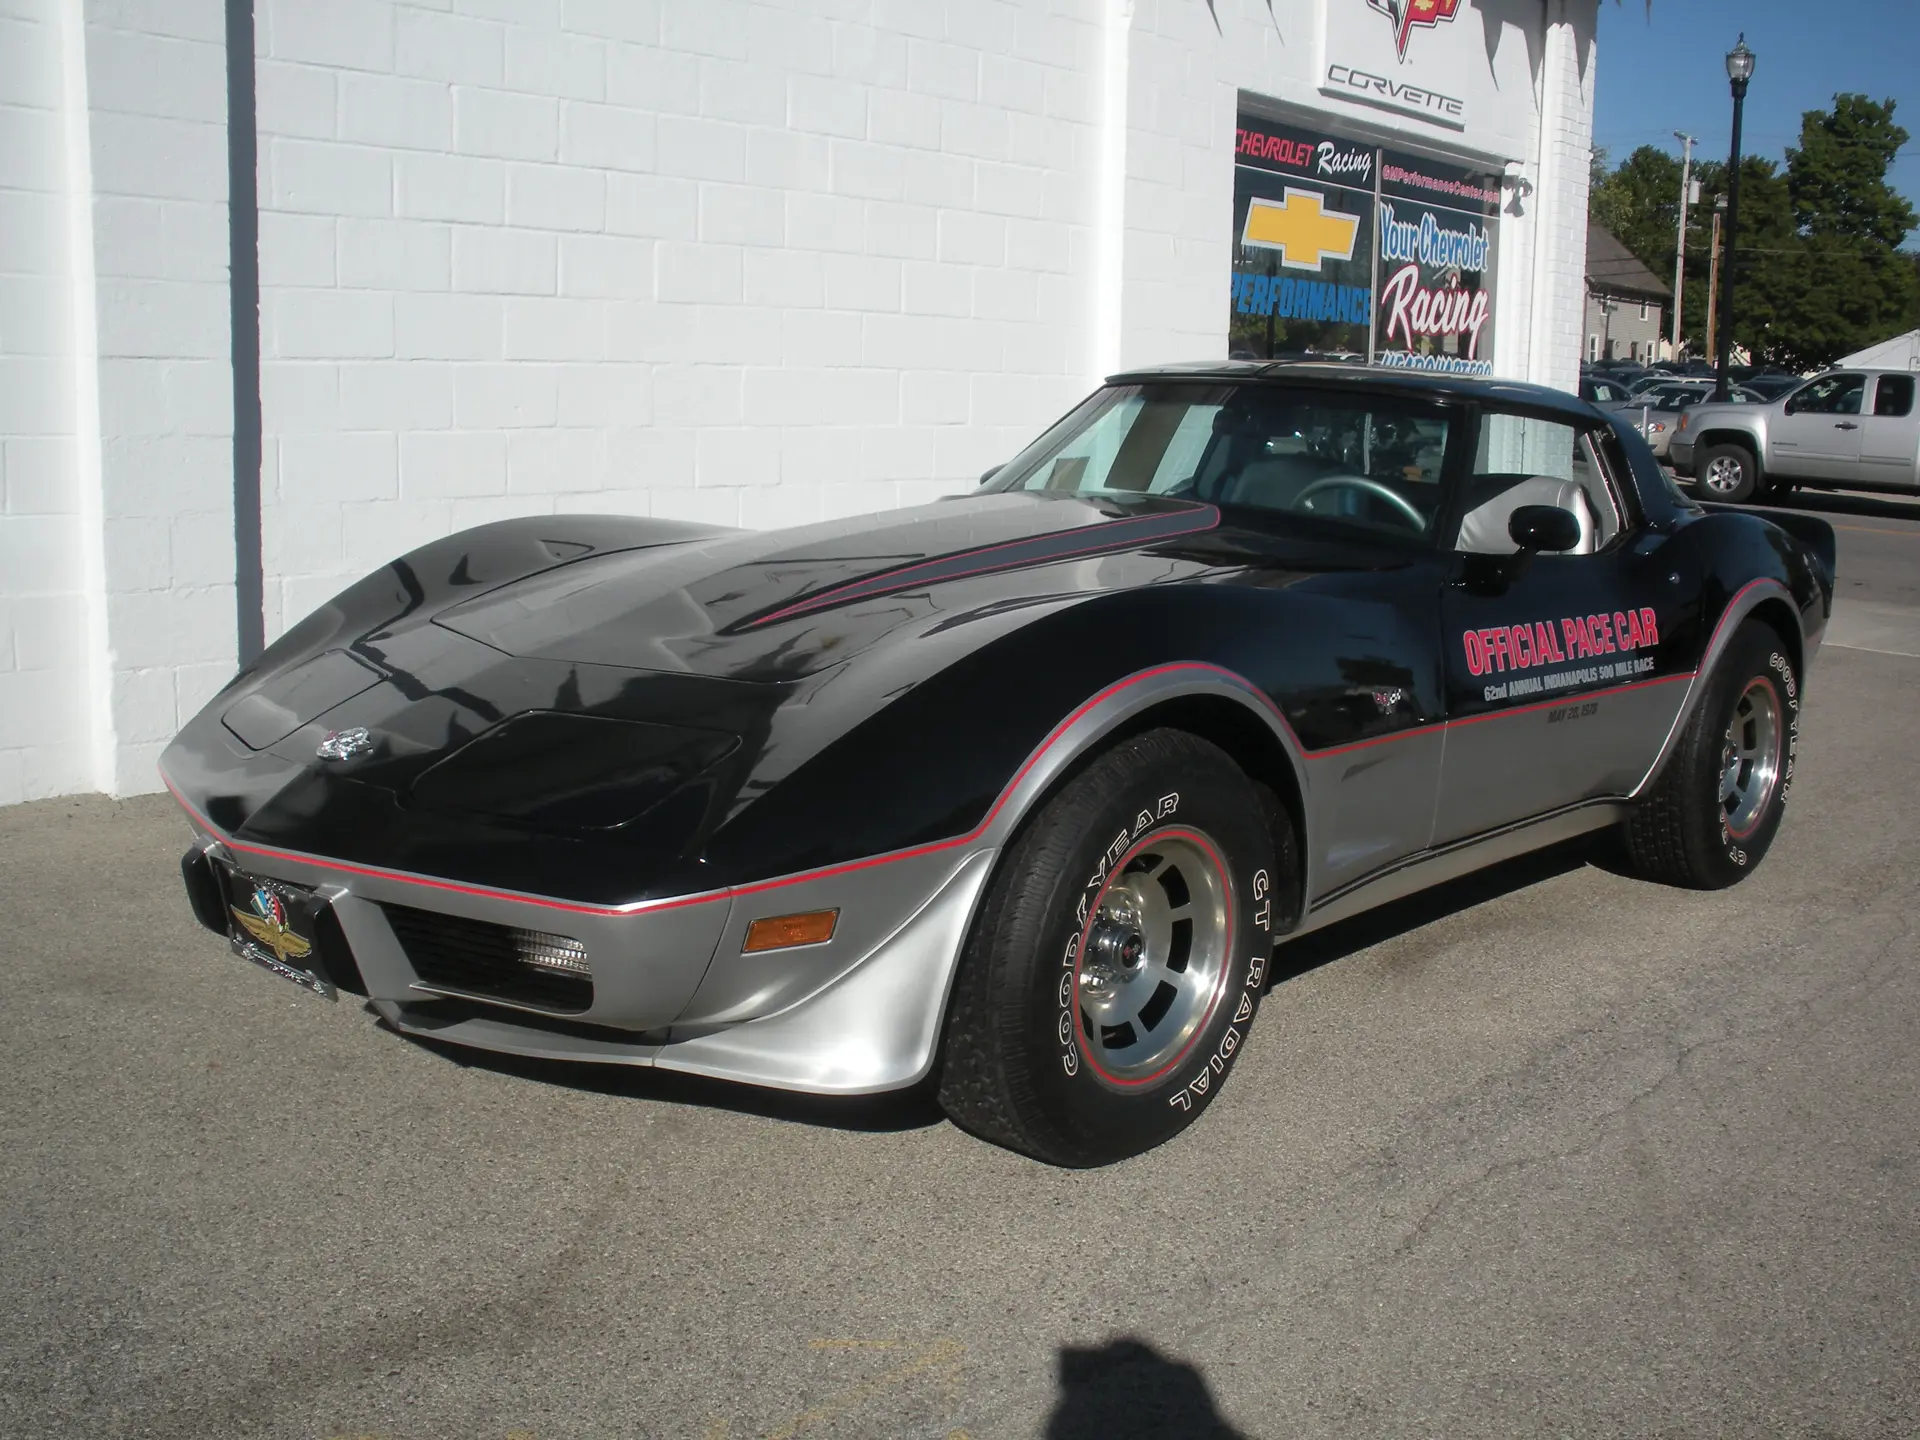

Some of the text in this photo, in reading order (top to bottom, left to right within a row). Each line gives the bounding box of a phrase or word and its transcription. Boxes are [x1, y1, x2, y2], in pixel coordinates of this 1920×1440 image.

[1328, 64, 1464, 115] CORVETTE
[1235, 128, 1372, 182] CHEVROLET Racing
[1382, 164, 1500, 204] GMPerformanceCenter.com
[1380, 201, 1490, 273] Your Chevrolet
[1230, 271, 1372, 326] PERFORMANCE
[1381, 263, 1489, 360] Racing
[1463, 607, 1659, 676] OFFICIAL PACE CAR
[1484, 656, 1655, 701] 62nd ANNUAL INDIANAPOLIS 500 MILE RACE
[1729, 845, 1748, 866] GT
[1058, 791, 1180, 1076] GOODYEAR
[1169, 868, 1270, 1111] GT RADIAL
